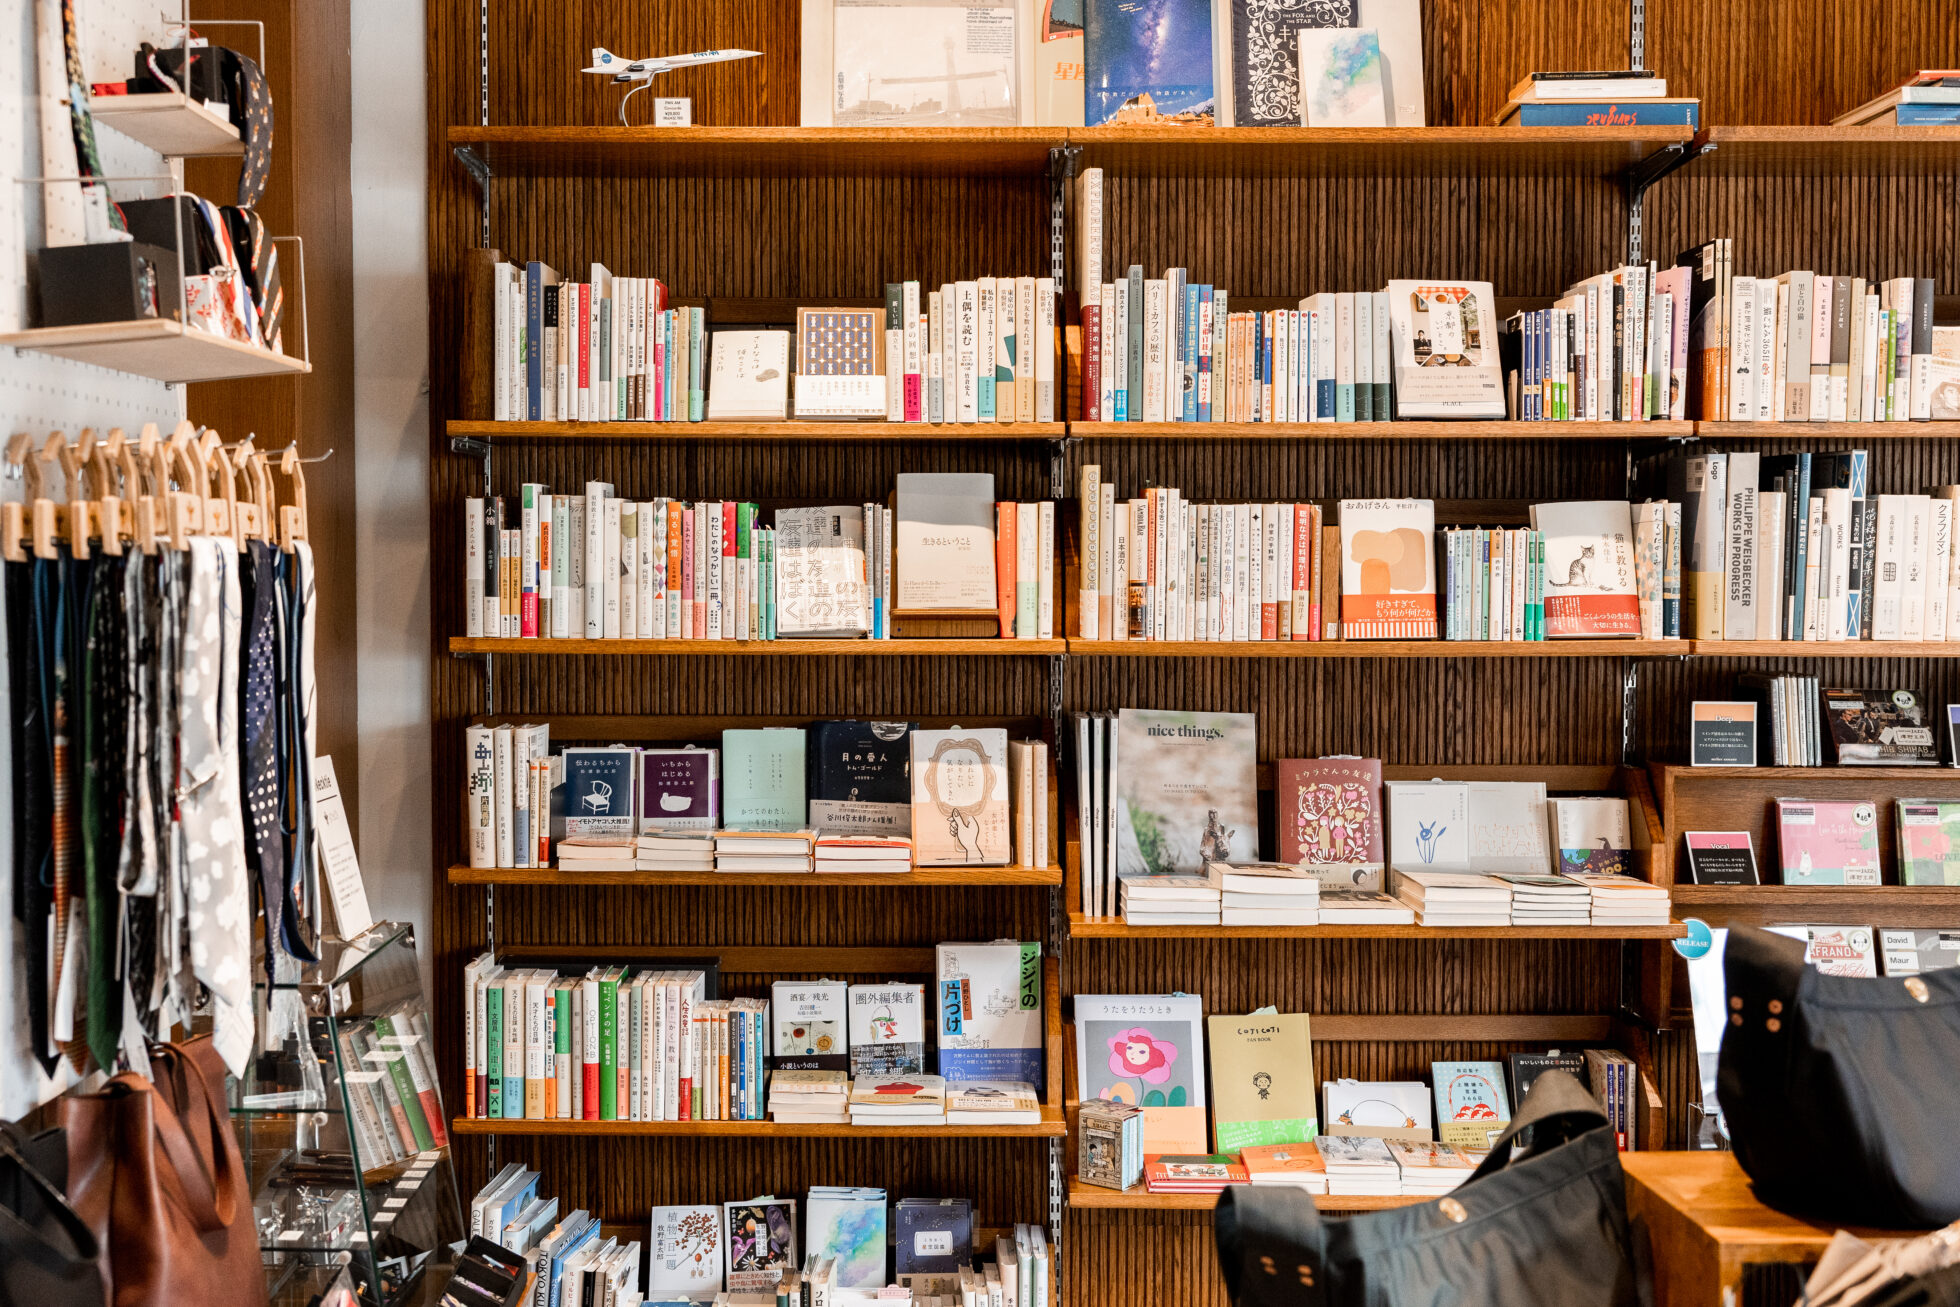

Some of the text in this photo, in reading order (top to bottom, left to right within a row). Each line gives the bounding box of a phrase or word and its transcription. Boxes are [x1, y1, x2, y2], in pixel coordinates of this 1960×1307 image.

[1089, 170, 1101, 302] EXPLORER'S ATLAS
[962, 290, 973, 346] 土偶を読む
[1150, 283, 1160, 364] パリとカフェの歴史
[1711, 461, 1719, 480] Logo
[1345, 501, 1391, 510] おあげさん
[485, 506, 496, 526] 小箱
[670, 511, 679, 557] 明るい覚悟
[1200, 518, 1208, 550] 家のしごと
[1936, 504, 1948, 556] クラフツマン
[922, 537, 972, 546] 生きるということ
[1731, 493, 1743, 601] WORKS IN PROGRESS
[1741, 487, 1754, 607] PHILIPPE WEISBECKER
[710, 516, 719, 600] わたしのなつかしい一冊
[1117, 536, 1126, 572] 日本酒の人
[1614, 532, 1627, 587] 猫に教わる
[1375, 600, 1421, 609] 好きすぎて、
[1376, 609, 1434, 618] もう何が何だか
[1583, 613, 1639, 621] ごくふつうの生活を、
[1592, 621, 1633, 629] 大切に生きる。
[1715, 714, 1735, 724] Deep
[1147, 724, 1225, 741] nice things.
[841, 752, 888, 762] 月の番人
[1897, 746, 1929, 754] SHIHAB
[575, 759, 621, 767] 伝わるちから
[1295, 767, 1372, 782] ミウラさんの友達
[1676, 939, 1709, 948] RELEASE
[1887, 936, 1908, 944] David
[1021, 951, 1038, 1009] ジジイの
[855, 991, 915, 1005] 圏外編集者
[945, 983, 961, 1033] 片づけ
[1103, 1005, 1172, 1014] うたをうたうとき
[1237, 1026, 1280, 1036] COJI COJI
[780, 1061, 819, 1070] 小説というのは
[656, 1225, 665, 1261] 牧野富太郎
[666, 1211, 679, 1271] 植物一日一題
[537, 1252, 548, 1291] TOKYO
